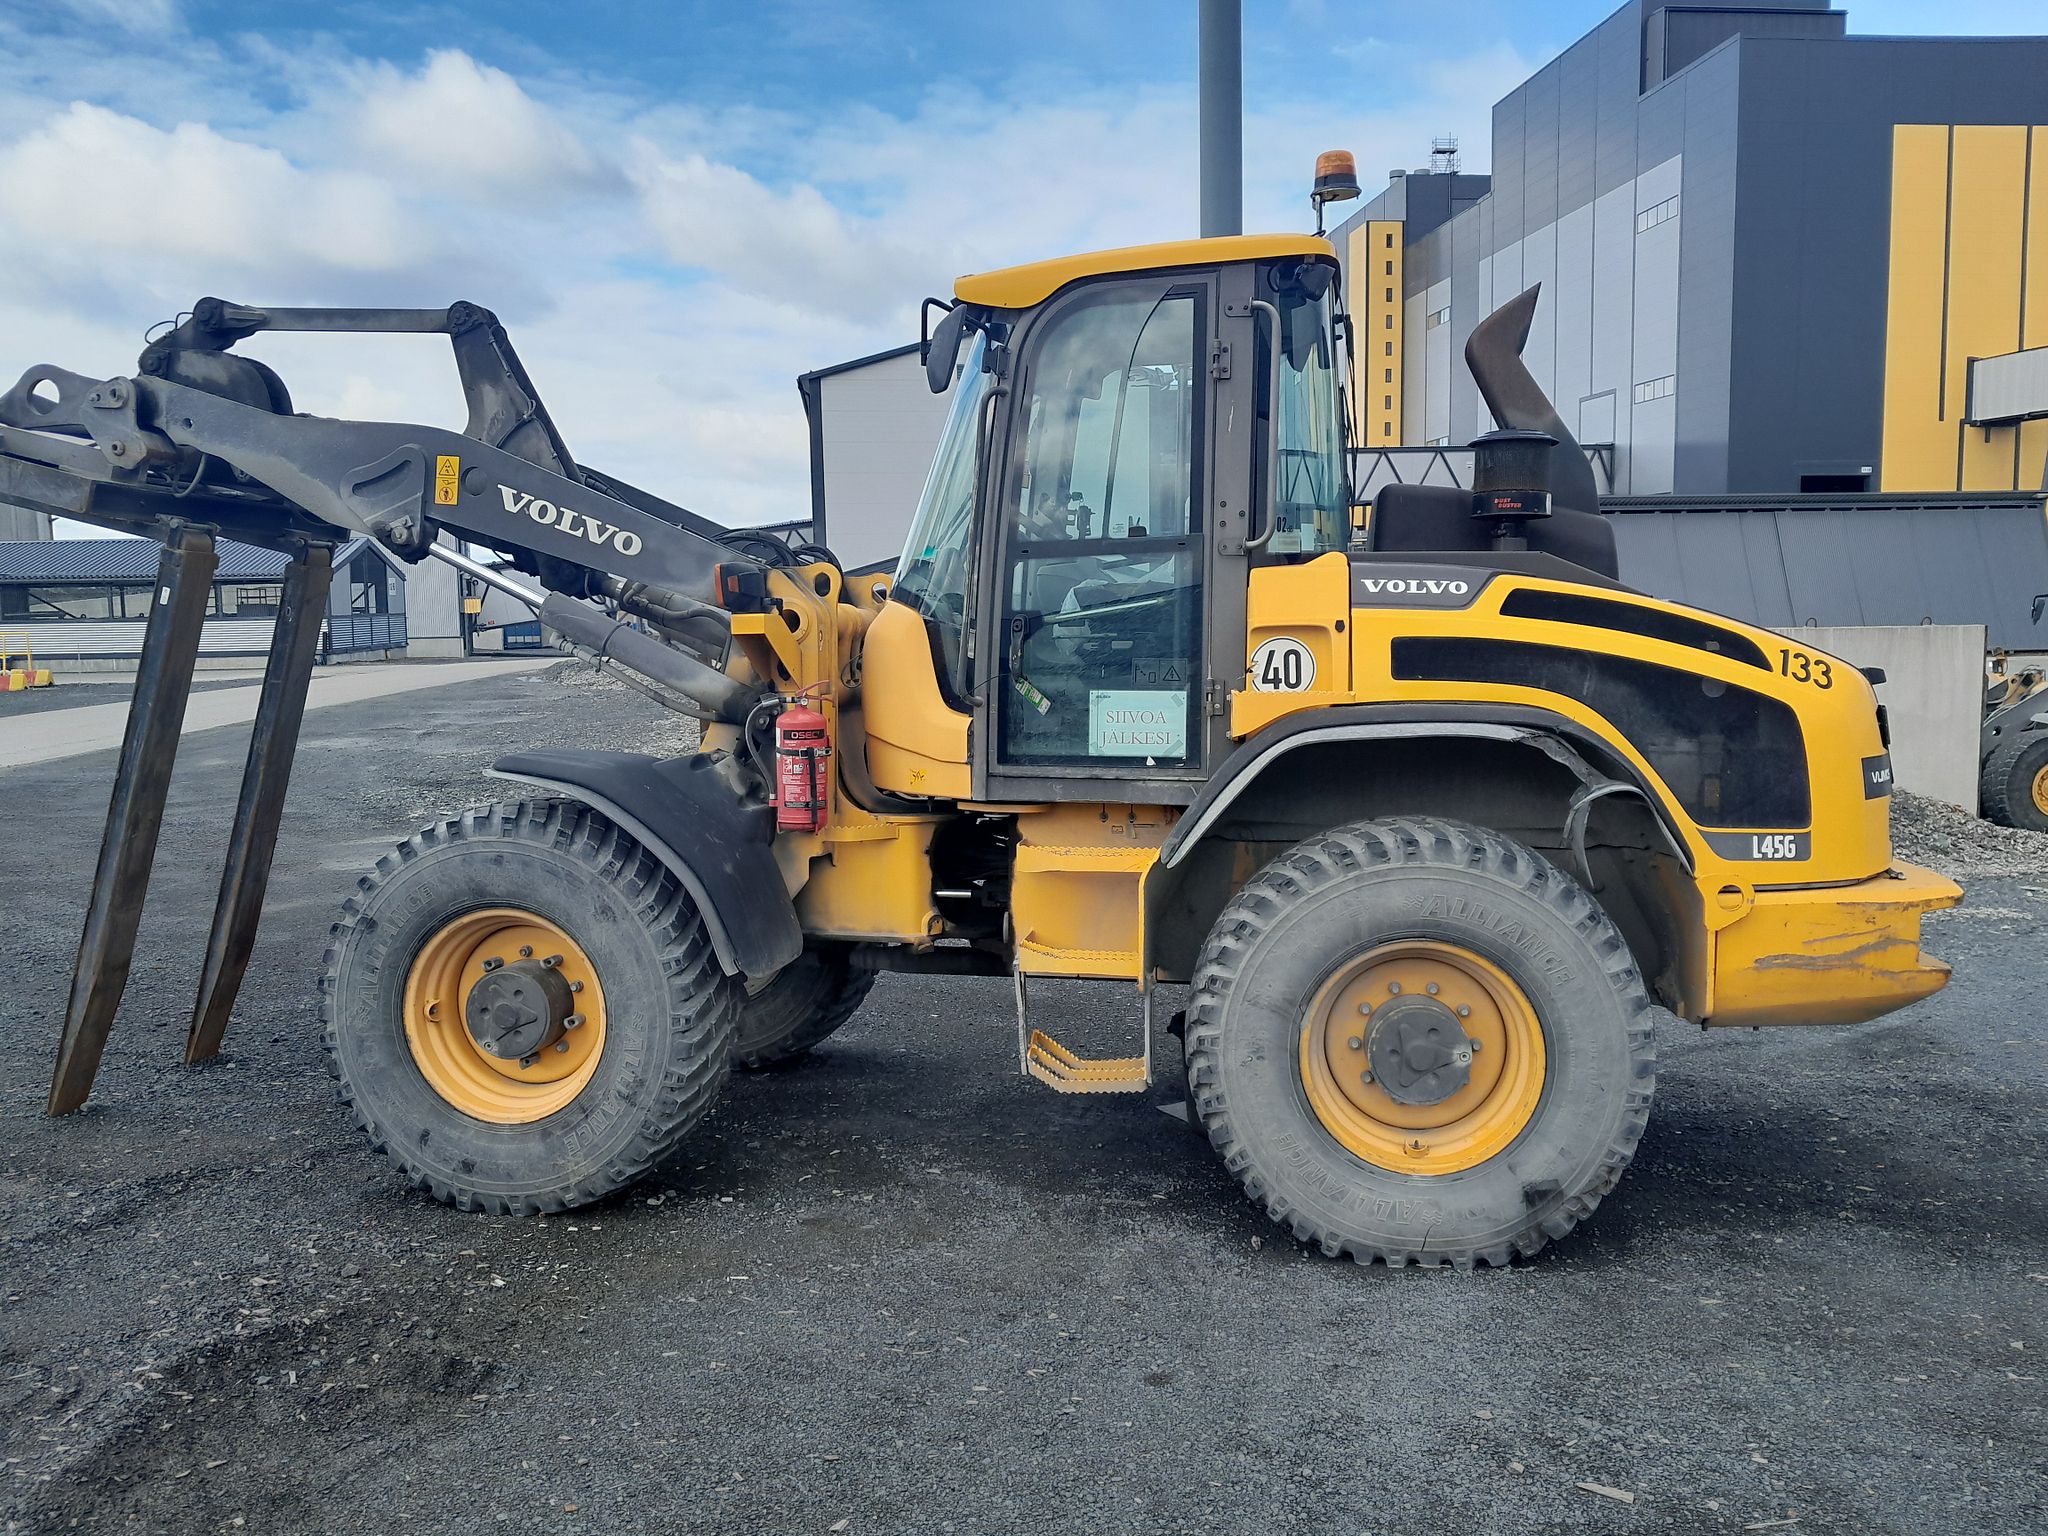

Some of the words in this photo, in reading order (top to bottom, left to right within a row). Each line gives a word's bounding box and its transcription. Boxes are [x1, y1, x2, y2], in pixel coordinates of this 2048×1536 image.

[497, 483, 643, 556] VOLVO
[1360, 578, 1469, 595] VOLVO
[1261, 648, 1302, 690] 40
[1779, 649, 1833, 690] 133
[1098, 728, 1172, 748] JÄLKESI
[1105, 710, 1168, 724] SIIVOA
[1752, 835, 1797, 859] L45G
[357, 881, 434, 1009] ALLIANCE
[1420, 893, 1576, 987] ALLIANCE
[563, 1025, 643, 1157] ALLIANCE
[1272, 1132, 1423, 1225] ALLIANCE
